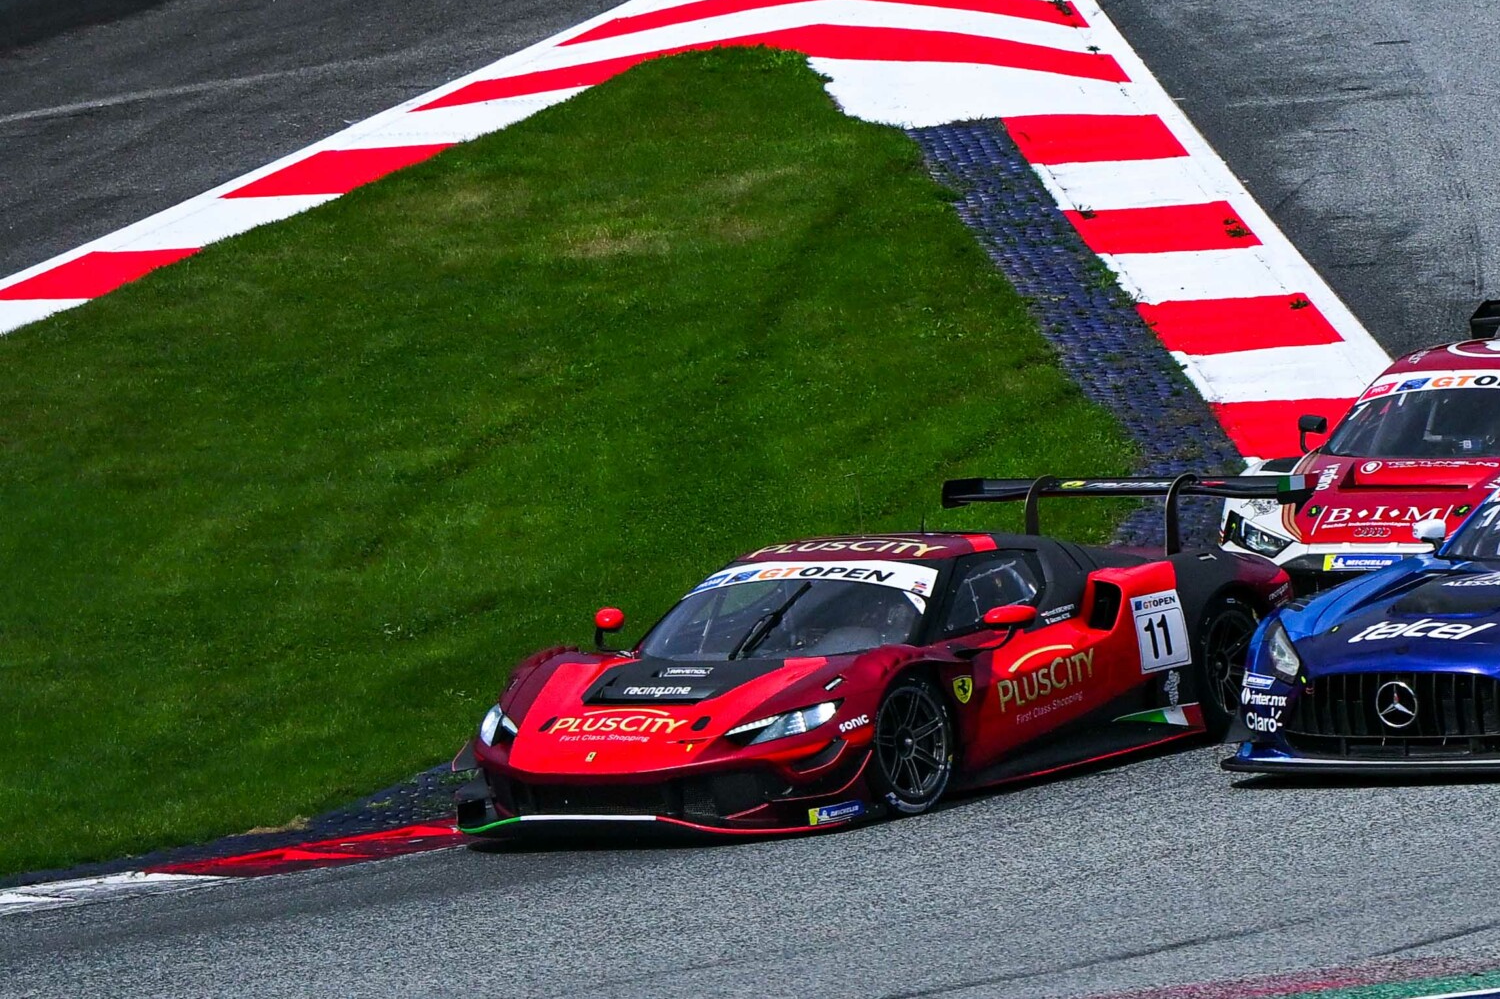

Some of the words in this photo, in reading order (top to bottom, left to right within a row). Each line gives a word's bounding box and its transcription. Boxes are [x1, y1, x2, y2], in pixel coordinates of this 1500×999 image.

[1370, 384, 1390, 395] PRO
[1143, 613, 1173, 660] 11
[1347, 618, 1498, 644] telcel
[998, 647, 1095, 713] PLUSCITY
[1250, 690, 1287, 707] inter.mx
[548, 716, 690, 735] PLUSCITY
[1246, 712, 1278, 733] Claro
[559, 735, 581, 743] First
[607, 734, 650, 743] Shopping
